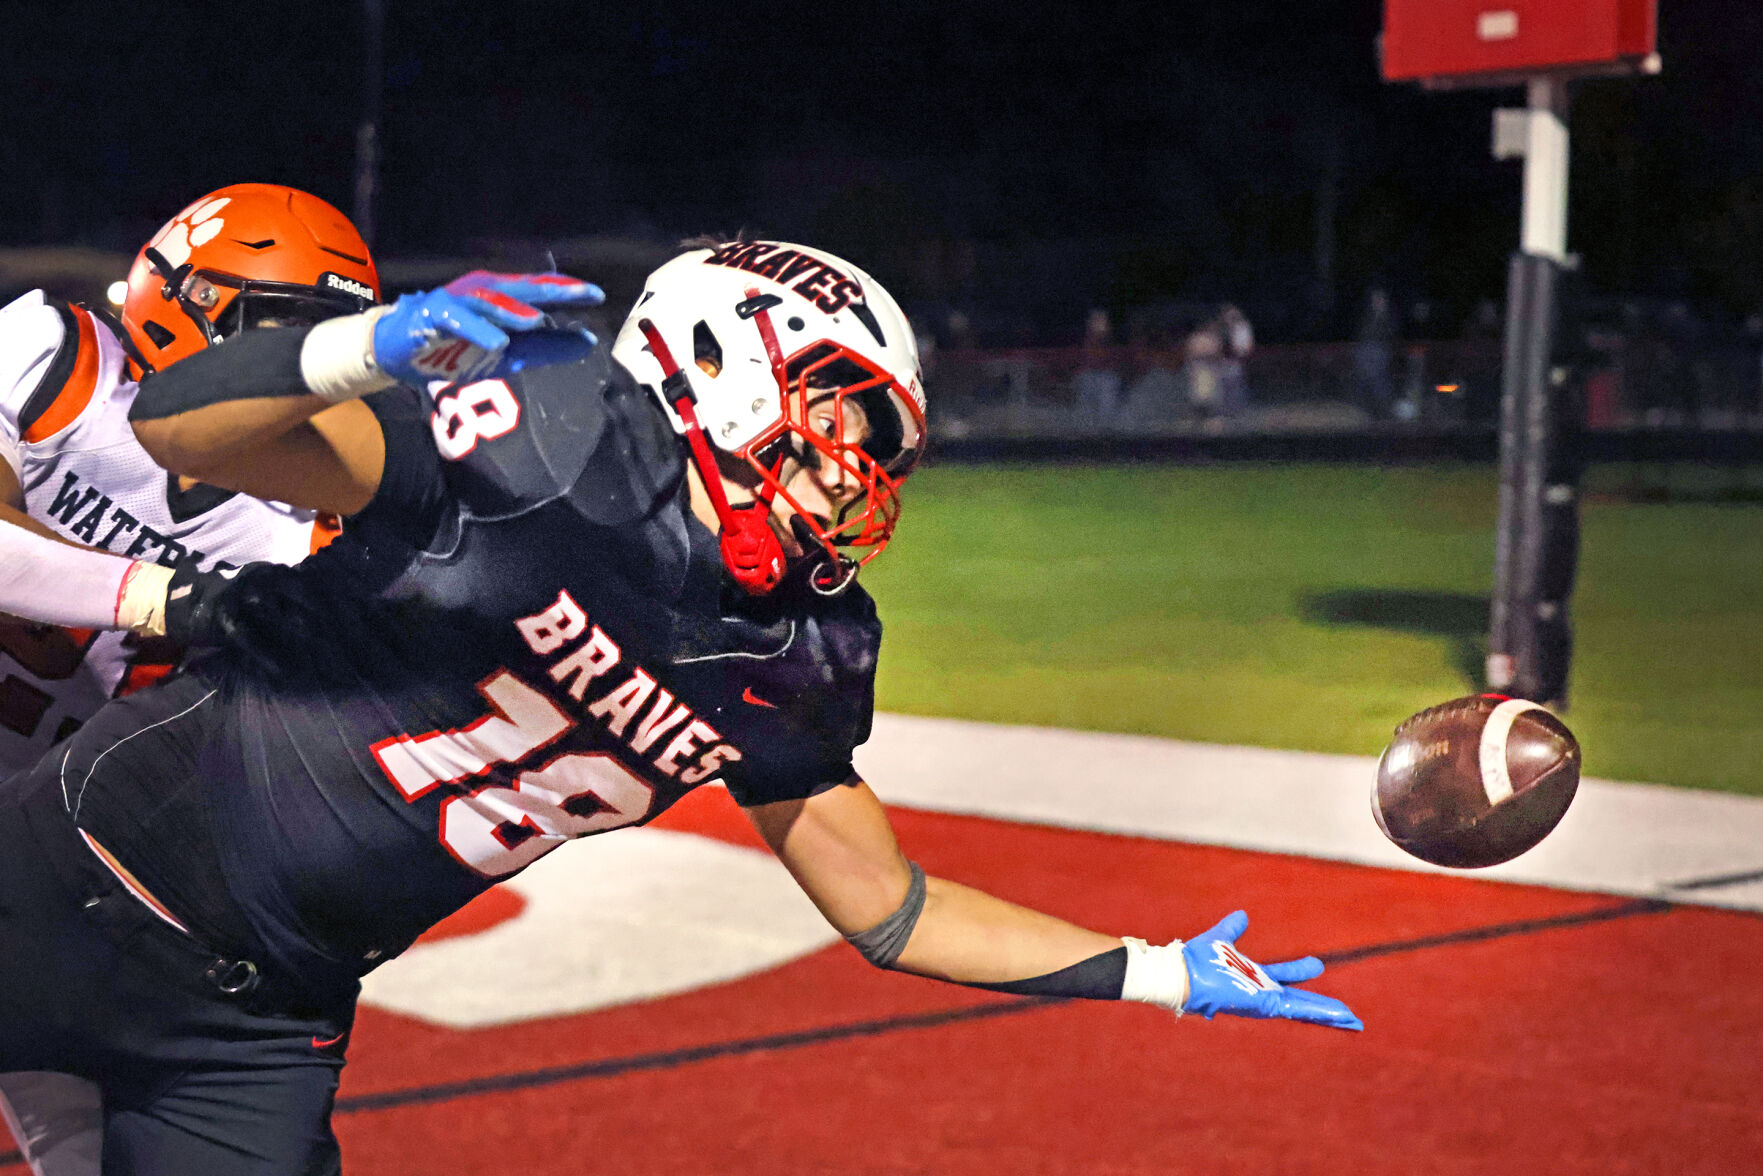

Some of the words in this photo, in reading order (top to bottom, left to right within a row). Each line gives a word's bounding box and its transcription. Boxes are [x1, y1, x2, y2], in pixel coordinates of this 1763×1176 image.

[327, 274, 374, 301] Riddell
[702, 240, 863, 315] BRAVES
[427, 379, 521, 460] 8
[47, 470, 236, 570] WATER
[513, 588, 743, 784] BRAVES
[369, 665, 656, 878] 78
